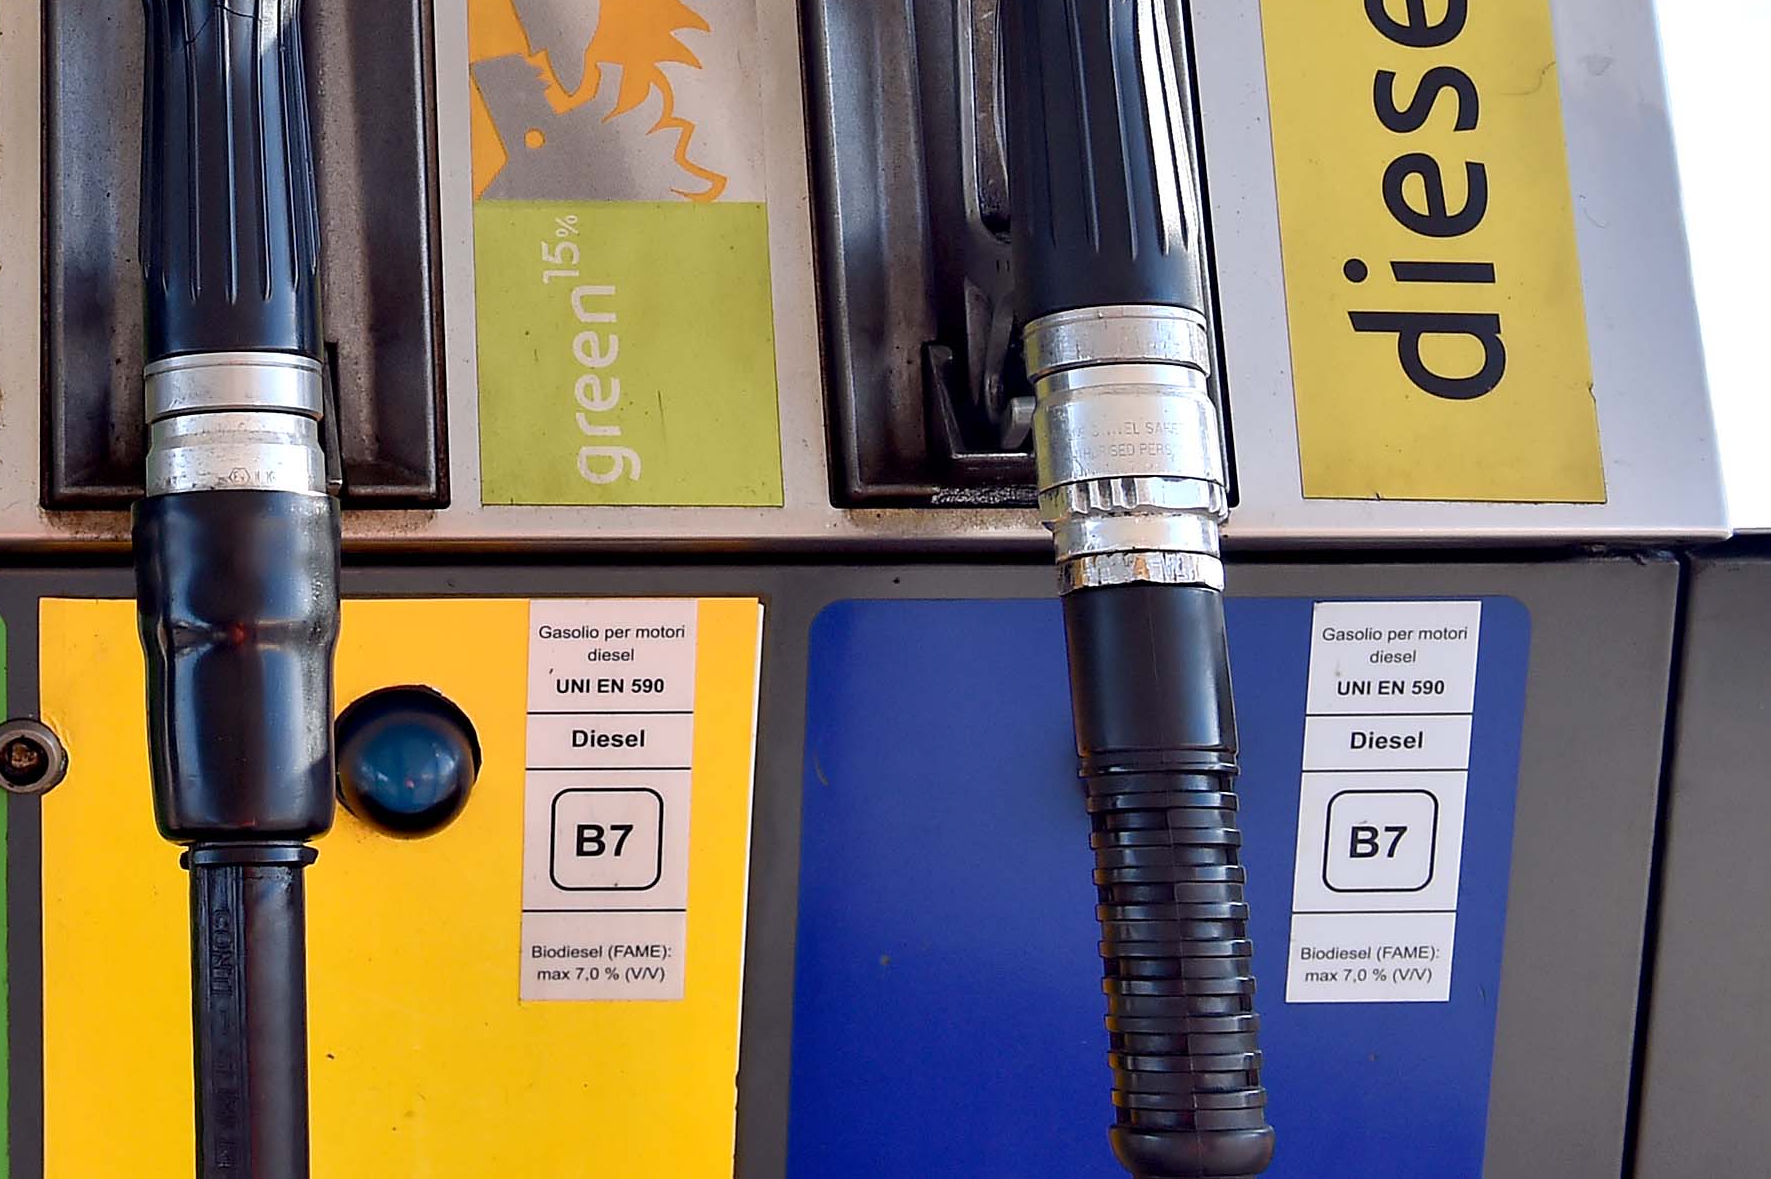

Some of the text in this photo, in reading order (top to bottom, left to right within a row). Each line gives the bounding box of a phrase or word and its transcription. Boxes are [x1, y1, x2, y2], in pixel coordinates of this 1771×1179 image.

[571, 285, 642, 484] green
[539, 625, 684, 641] Gasolio per motori
[1323, 627, 1467, 643] Gasolio per motori
[588, 649, 634, 661] diesel
[1370, 650, 1416, 663] diesel
[557, 679, 664, 693] UNI EN 590
[1338, 680, 1444, 695] UNI EN 590
[573, 730, 644, 747] Diesel
[1351, 732, 1422, 749] Diesel
[576, 825, 633, 856] B7
[1350, 826, 1407, 858] B7
[532, 945, 670, 961] Biodiesel (FAME):
[1301, 946, 1439, 962] Biodiesel (FAME):
[538, 967, 665, 982] max 7,0 % (V/V)
[1305, 968, 1432, 983] max 7,0 % (V/V)
